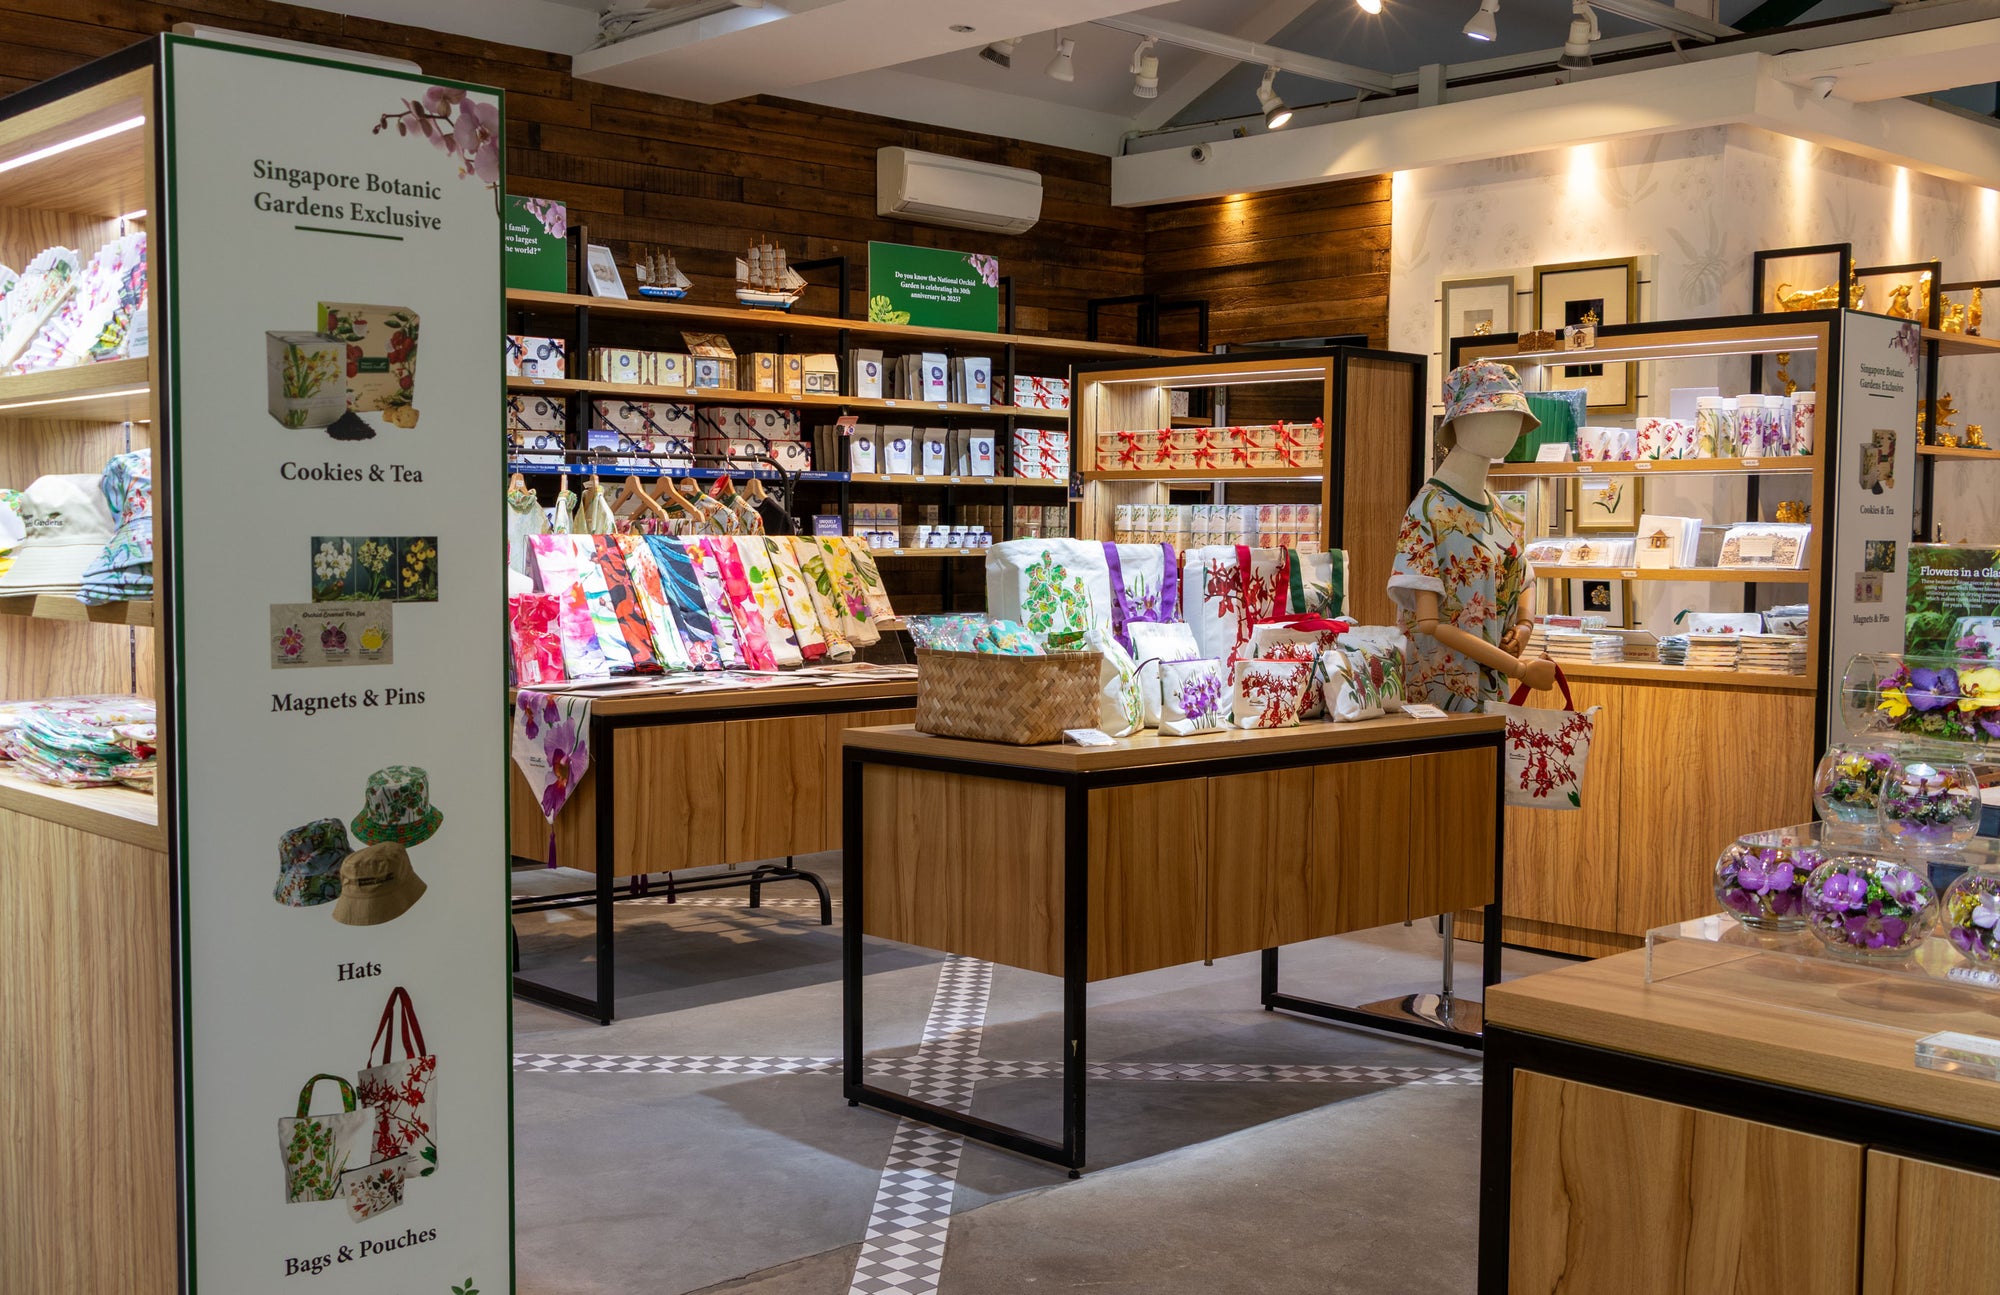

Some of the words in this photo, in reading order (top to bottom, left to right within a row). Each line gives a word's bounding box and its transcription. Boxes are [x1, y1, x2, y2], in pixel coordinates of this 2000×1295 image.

[253, 159, 360, 190] Singapore
[366, 173, 441, 200] Botanic
[254, 192, 344, 219] Gardens
[350, 202, 441, 230] Exclusive
[508, 223, 530, 234] family
[515, 235, 538, 245] largest
[505, 244, 514, 252] he
[914, 273, 928, 281] know
[937, 276, 959, 285] National
[959, 278, 976, 286] Orchid
[900, 281, 919, 289] Garden
[925, 284, 952, 294] celebrating
[960, 287, 971, 295] 30th
[911, 292, 940, 302] anniversary
[1860, 363, 1885, 377] Singapore
[1886, 366, 1904, 378] Botanic
[1860, 378, 1881, 390] Gardens
[1882, 381, 1904, 392] Exclusive
[280, 461, 363, 481] Cookies
[368, 464, 385, 482] &
[390, 464, 423, 482] Tea
[1860, 505, 1880, 515] Cookies
[1880, 505, 1885, 514] &
[1886, 506, 1894, 515] Tea
[1920, 566, 1959, 576] Flowers
[1961, 567, 1971, 577] in
[1973, 569, 1980, 577] a
[1853, 614, 1874, 626] Magnets
[1874, 613, 1879, 623] &
[1879, 613, 1889, 623] Pins
[271, 692, 357, 716] Magnets
[363, 689, 379, 707] &
[385, 687, 425, 706] Pins
[337, 961, 382, 982] Hats
[285, 1253, 331, 1276] Bags
[337, 1245, 354, 1263] &
[360, 1228, 437, 1258] Pouches
